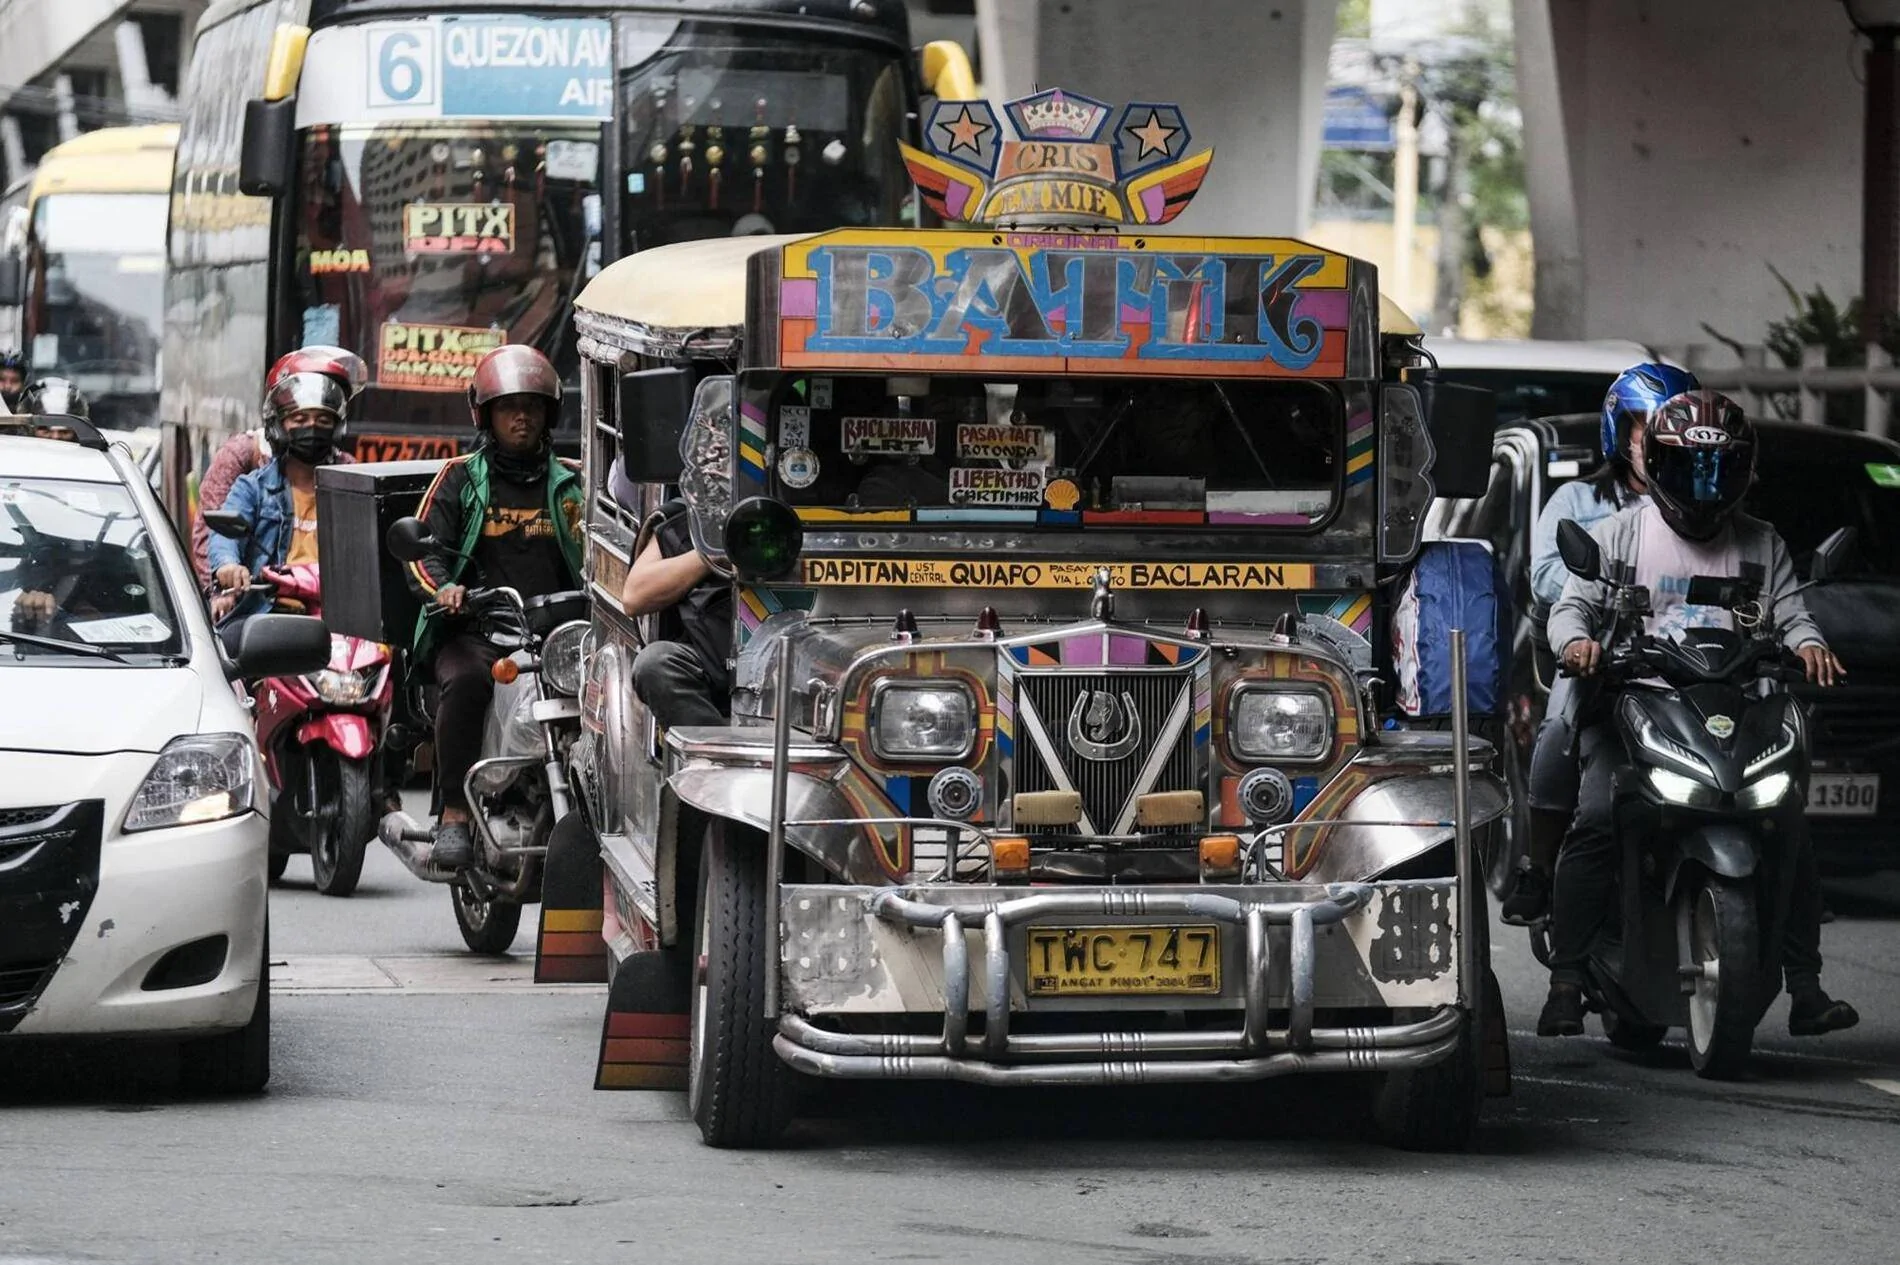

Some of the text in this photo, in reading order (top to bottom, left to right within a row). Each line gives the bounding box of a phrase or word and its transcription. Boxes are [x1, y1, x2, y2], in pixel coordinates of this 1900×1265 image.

[446, 26, 569, 69] QUEZON
[379, 32, 423, 101] 6
[1016, 143, 1099, 172] CRIS
[1001, 181, 1107, 216] EMMIE
[409, 206, 511, 238] PITX
[1007, 233, 1129, 250] ORIGINAL
[310, 249, 371, 274] MOA
[385, 325, 463, 353] PITX
[860, 438, 925, 452] LRT
[959, 426, 1042, 446] PASAY TAFT
[960, 444, 1038, 458] ROTONDA
[952, 469, 1041, 490] LIBERTAD
[952, 488, 1040, 503] CARTIMAR
[809, 560, 1285, 587] DAPITAN QUIAPO BACLARAN
[915, 562, 936, 571] UST
[1050, 564, 1090, 574] PASAY
[1053, 576, 1072, 586] VIA
[1813, 784, 1875, 808] 1300
